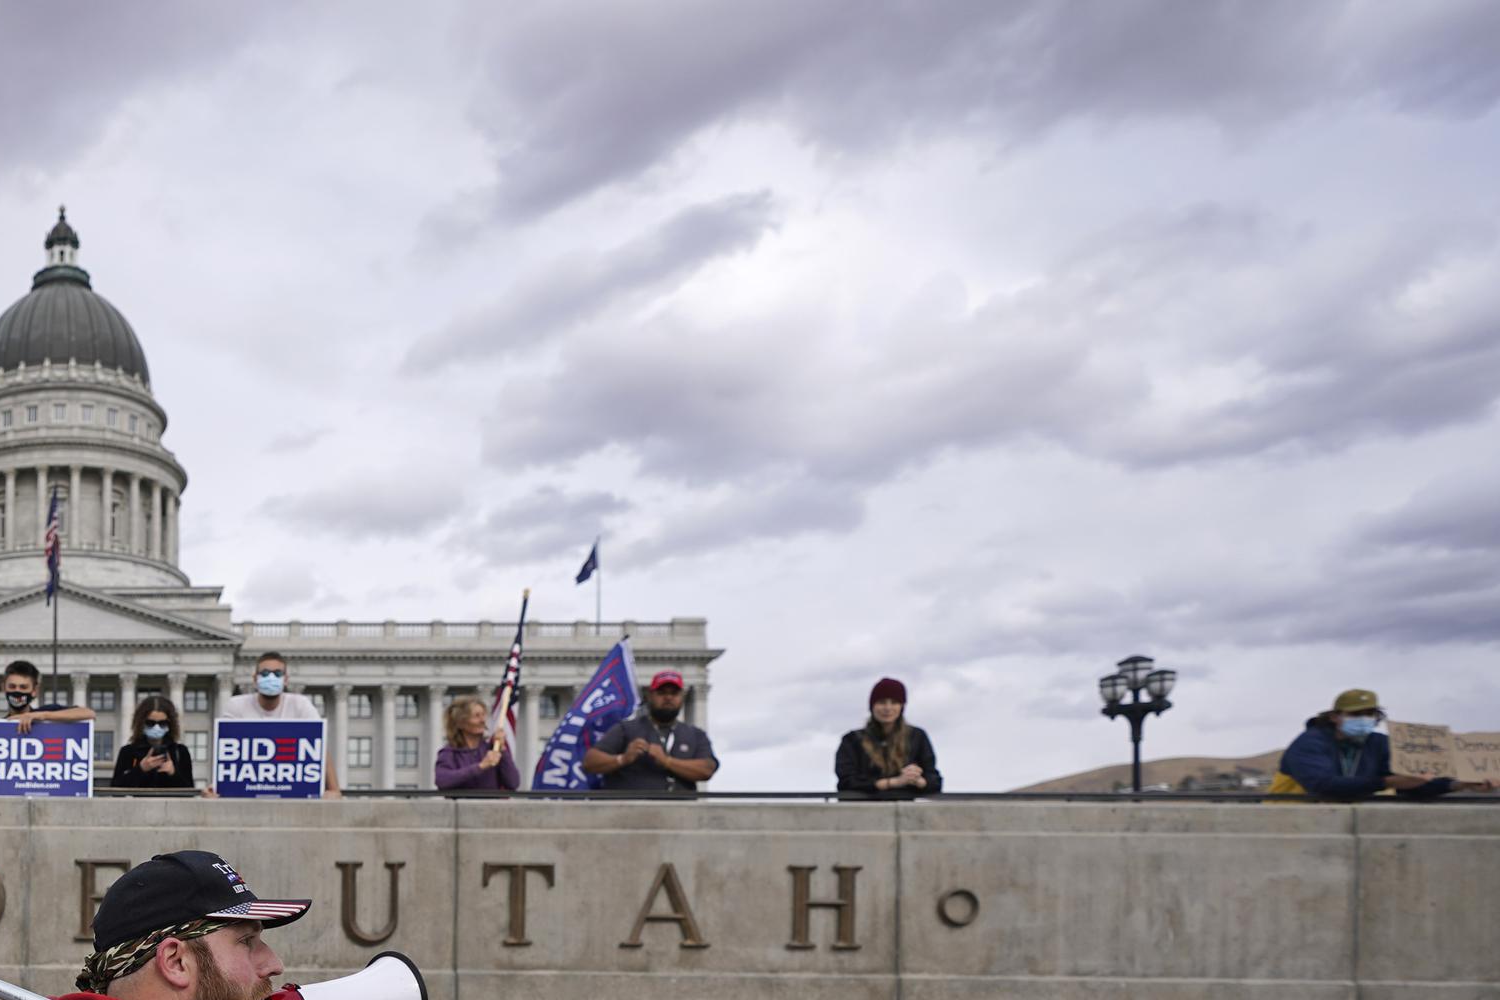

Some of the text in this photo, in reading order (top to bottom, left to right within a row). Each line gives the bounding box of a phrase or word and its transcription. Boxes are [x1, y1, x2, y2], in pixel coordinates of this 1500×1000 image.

[218, 738, 322, 761] BIDEN
[218, 763, 322, 783] HARRIS
[334, 861, 863, 951] UTAH
